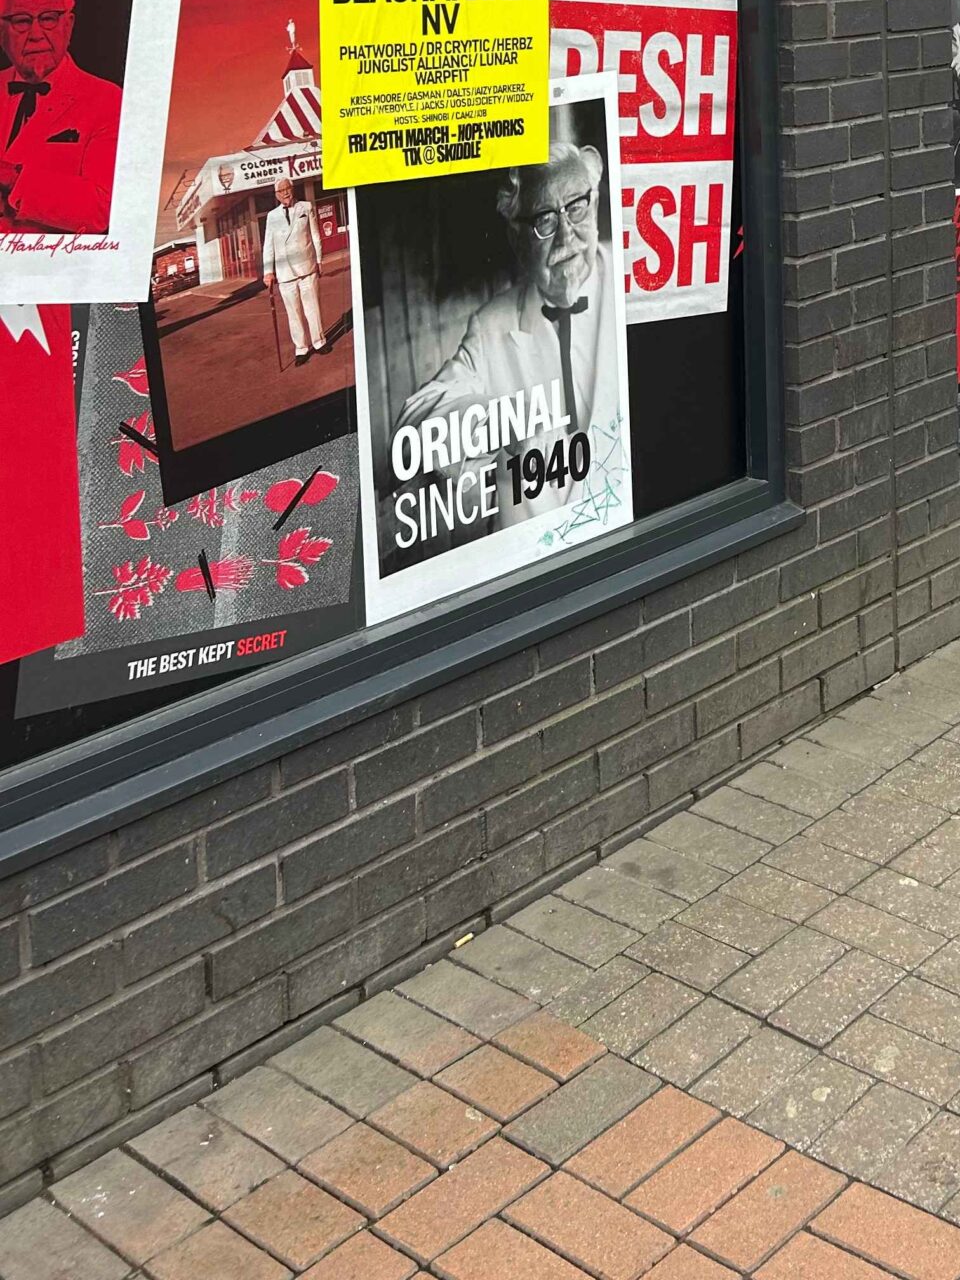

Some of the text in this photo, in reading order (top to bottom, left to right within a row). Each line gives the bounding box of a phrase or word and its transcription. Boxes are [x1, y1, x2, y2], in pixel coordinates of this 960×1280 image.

[421, 3, 460, 35] NV
[339, 42, 418, 60] PHATWORLD
[426, 41, 442, 55] DR
[357, 57, 415, 74] JUNGLIST
[479, 51, 518, 66] LUNAR
[414, 68, 469, 85] WARPFIT
[373, 92, 401, 104] MOORE
[407, 89, 441, 101] GASMAN
[446, 87, 471, 98] DALTS
[493, 83, 525, 94] DARKERZ
[339, 106, 372, 118] SWITCH
[420, 99, 444, 111] JACKS
[348, 132, 366, 154] FRI
[369, 129, 403, 152] 29TH
[405, 125, 449, 148] MARCH
[402, 141, 481, 166] TIX @ SKIDDLE
[243, 167, 284, 180] SANDERS
[62, 227, 120, 254] Sanders
[391, 379, 571, 481] ORIGINAL
[394, 462, 499, 549] SINCE
[507, 432, 591, 506] 1940
[127, 630, 287, 680] THE BEST KEPT SECRET
